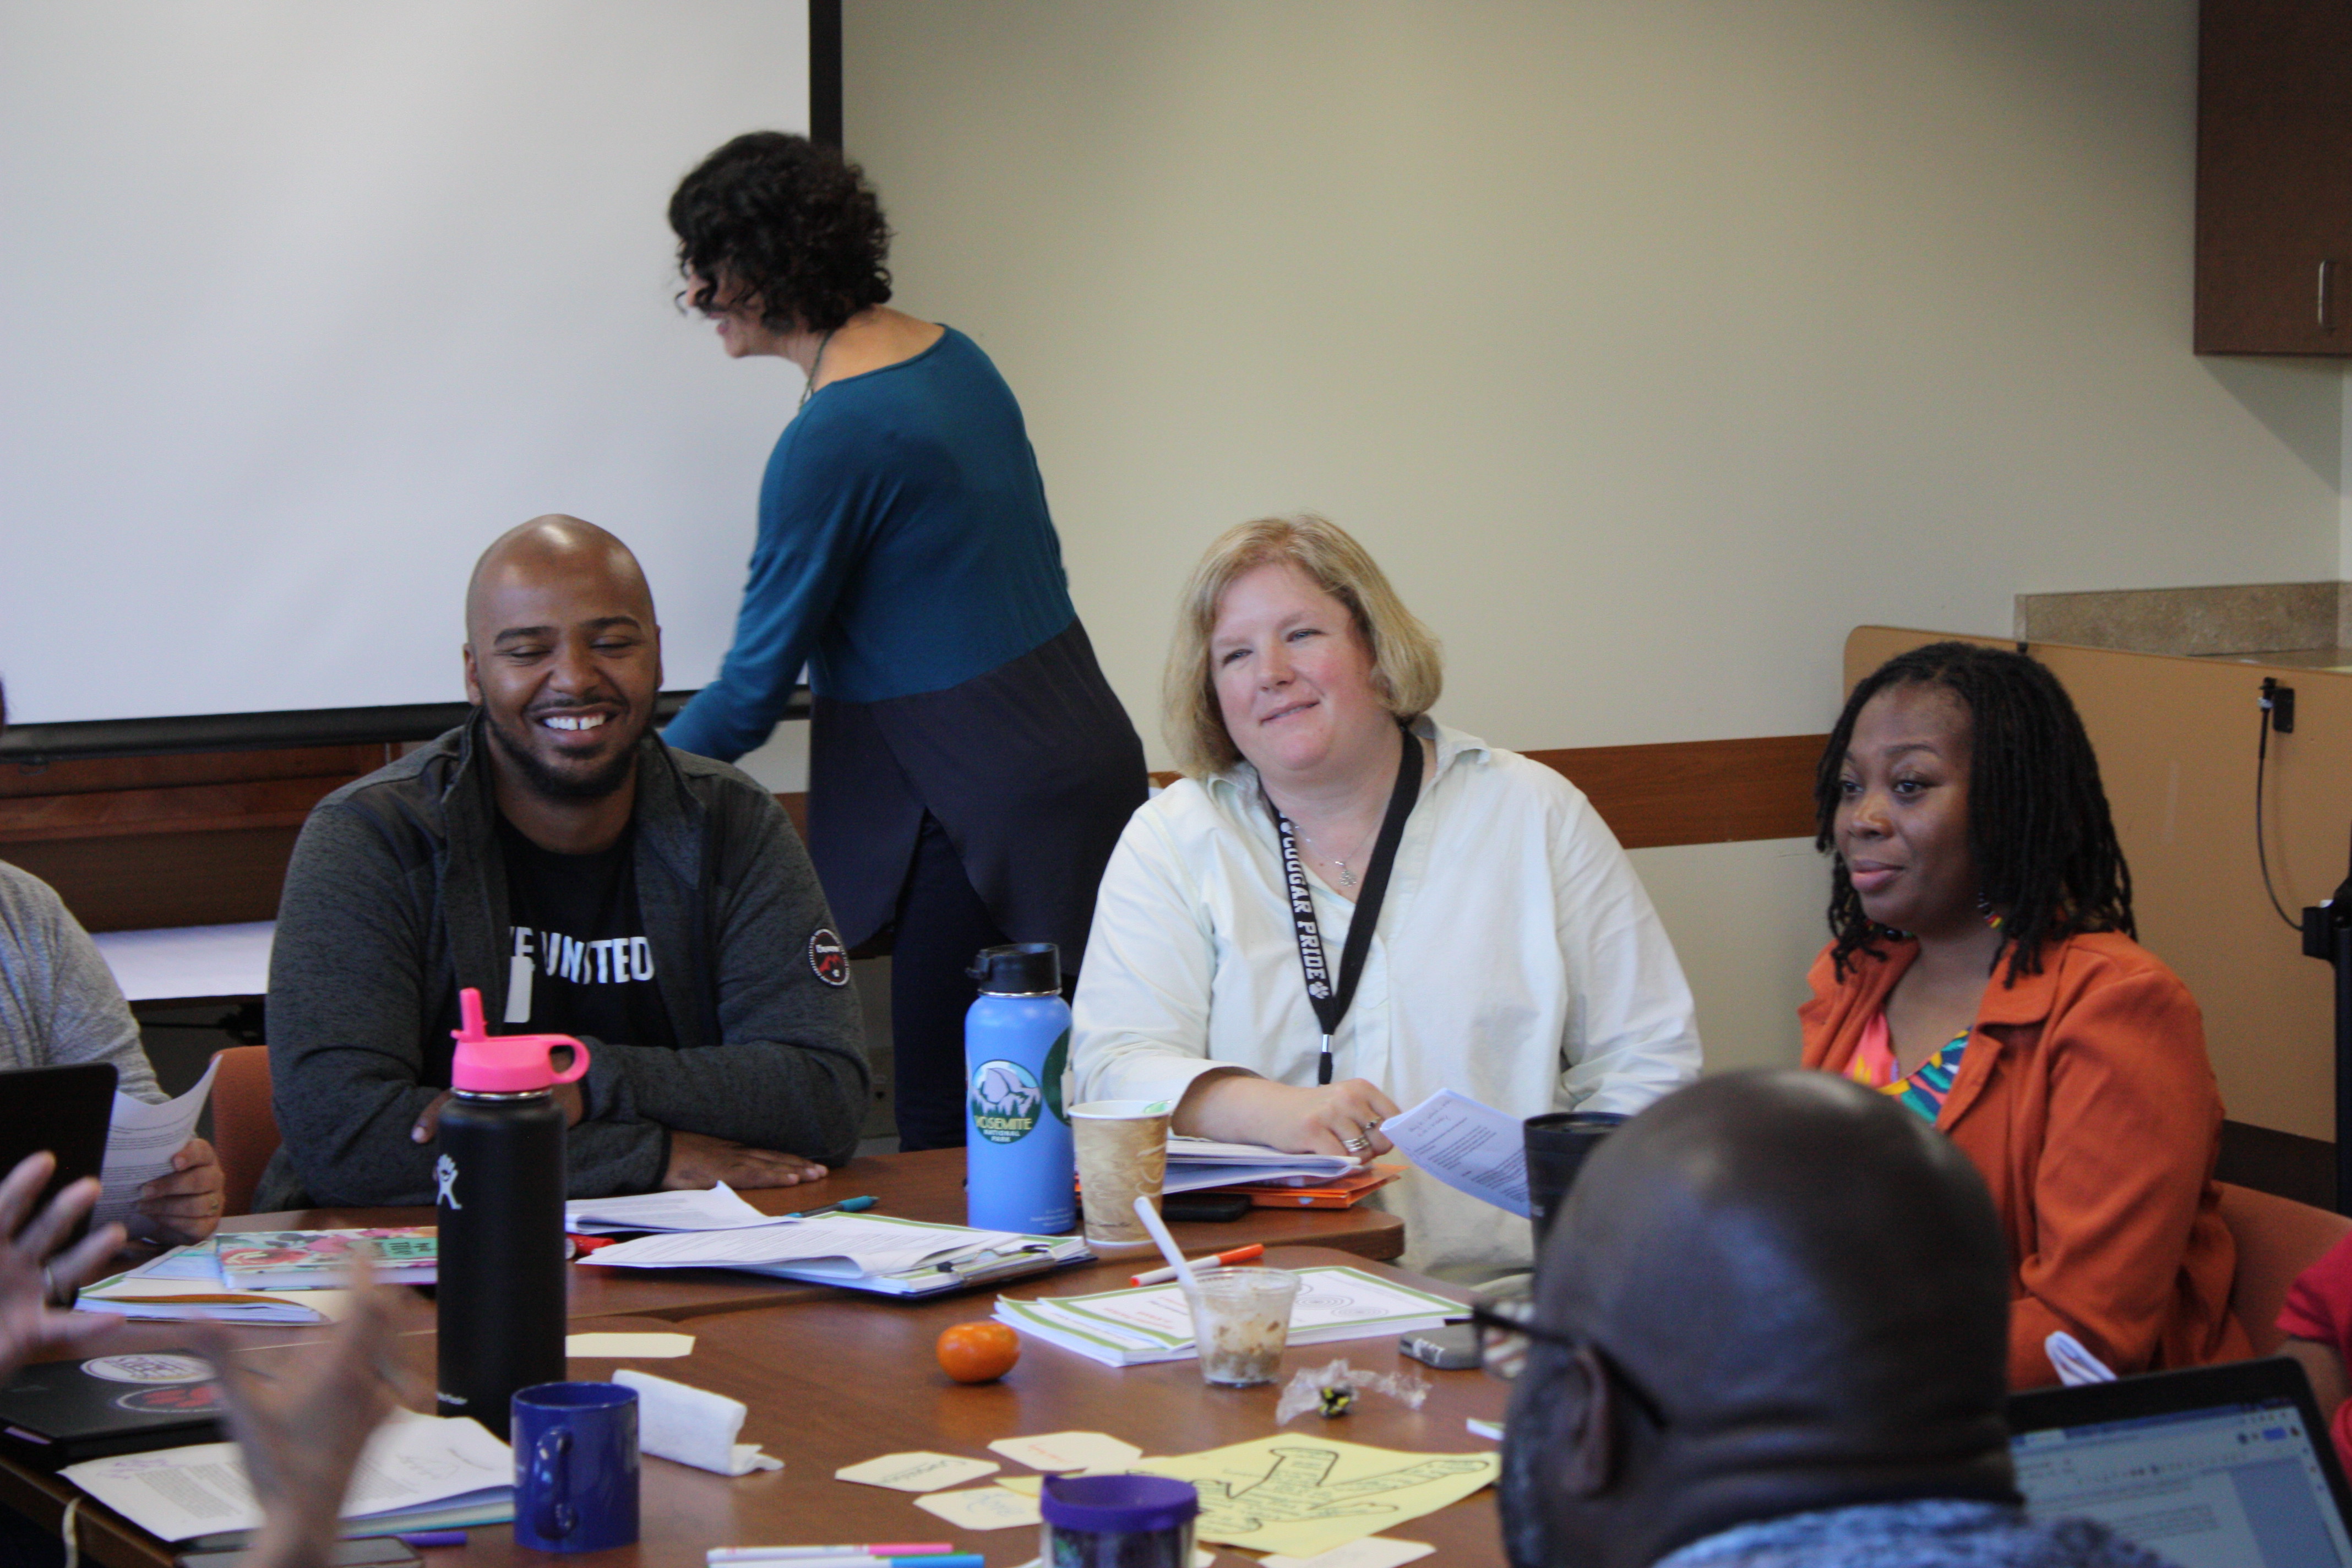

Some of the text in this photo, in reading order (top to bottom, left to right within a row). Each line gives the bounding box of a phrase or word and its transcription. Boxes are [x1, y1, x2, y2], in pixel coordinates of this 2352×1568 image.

[1282, 836, 1326, 980] COUGAR PRIDE
[541, 930, 655, 984] UNITED
[974, 1115, 1032, 1130] YOSEMITE
